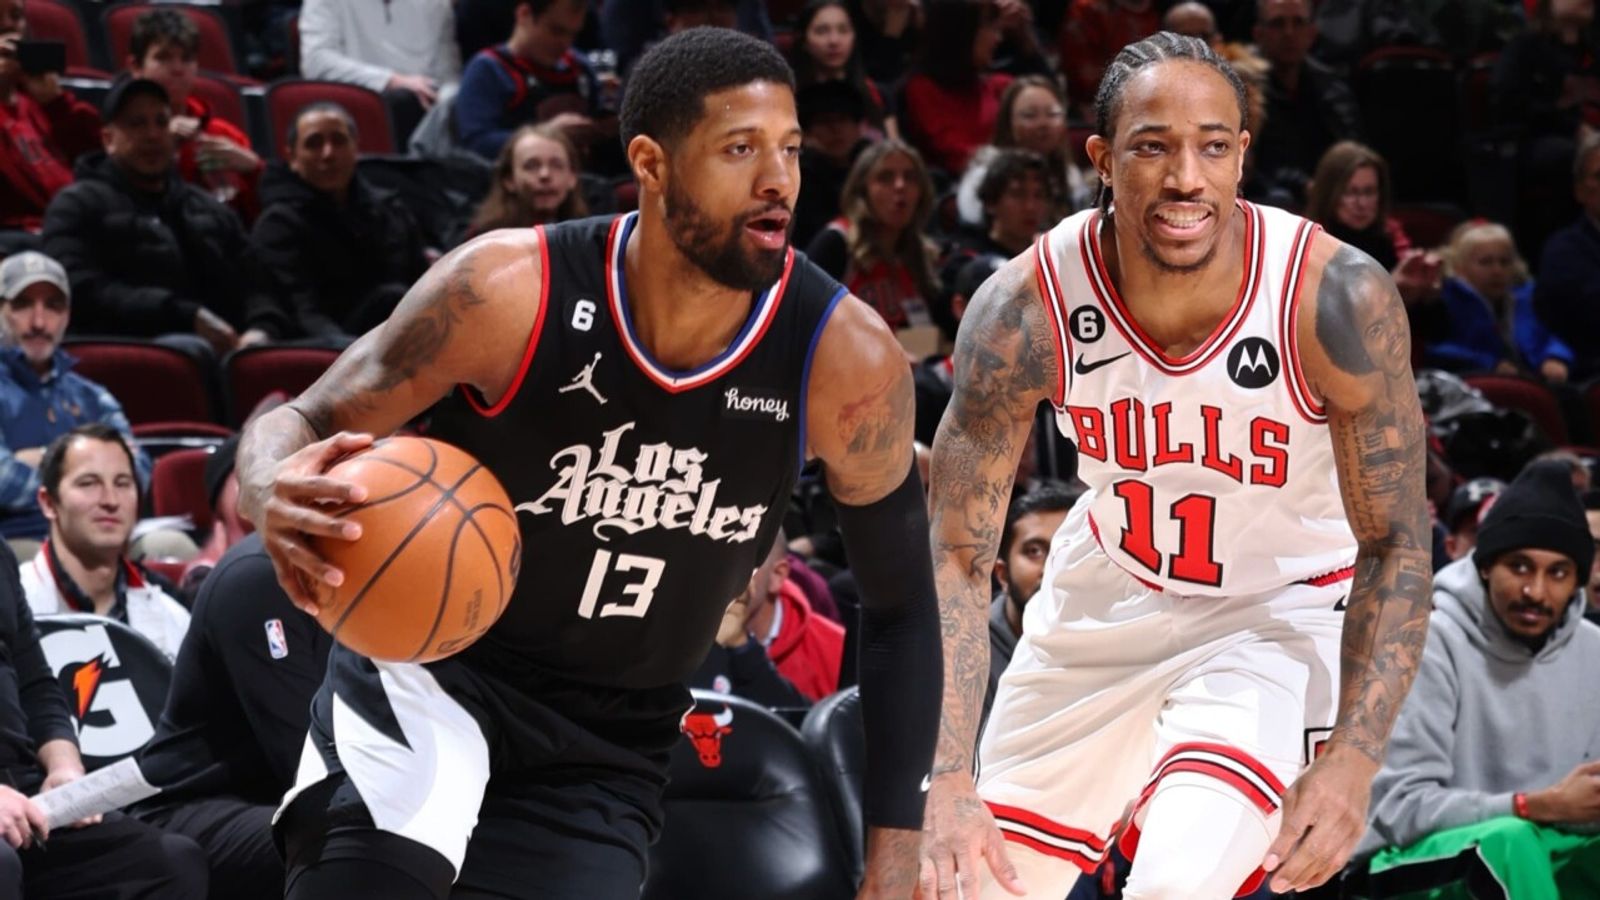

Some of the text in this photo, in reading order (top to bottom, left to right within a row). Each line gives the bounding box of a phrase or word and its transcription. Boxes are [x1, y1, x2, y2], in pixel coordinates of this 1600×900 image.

[571, 299, 597, 331] 6
[1078, 310, 1098, 339] 6
[724, 387, 790, 421] honey
[587, 421, 708, 494] Los
[1065, 397, 1290, 488] BULLS
[514, 444, 768, 544] Angeles
[1113, 479, 1223, 588] 11
[577, 548, 666, 619] 13
[39, 624, 156, 757] G
